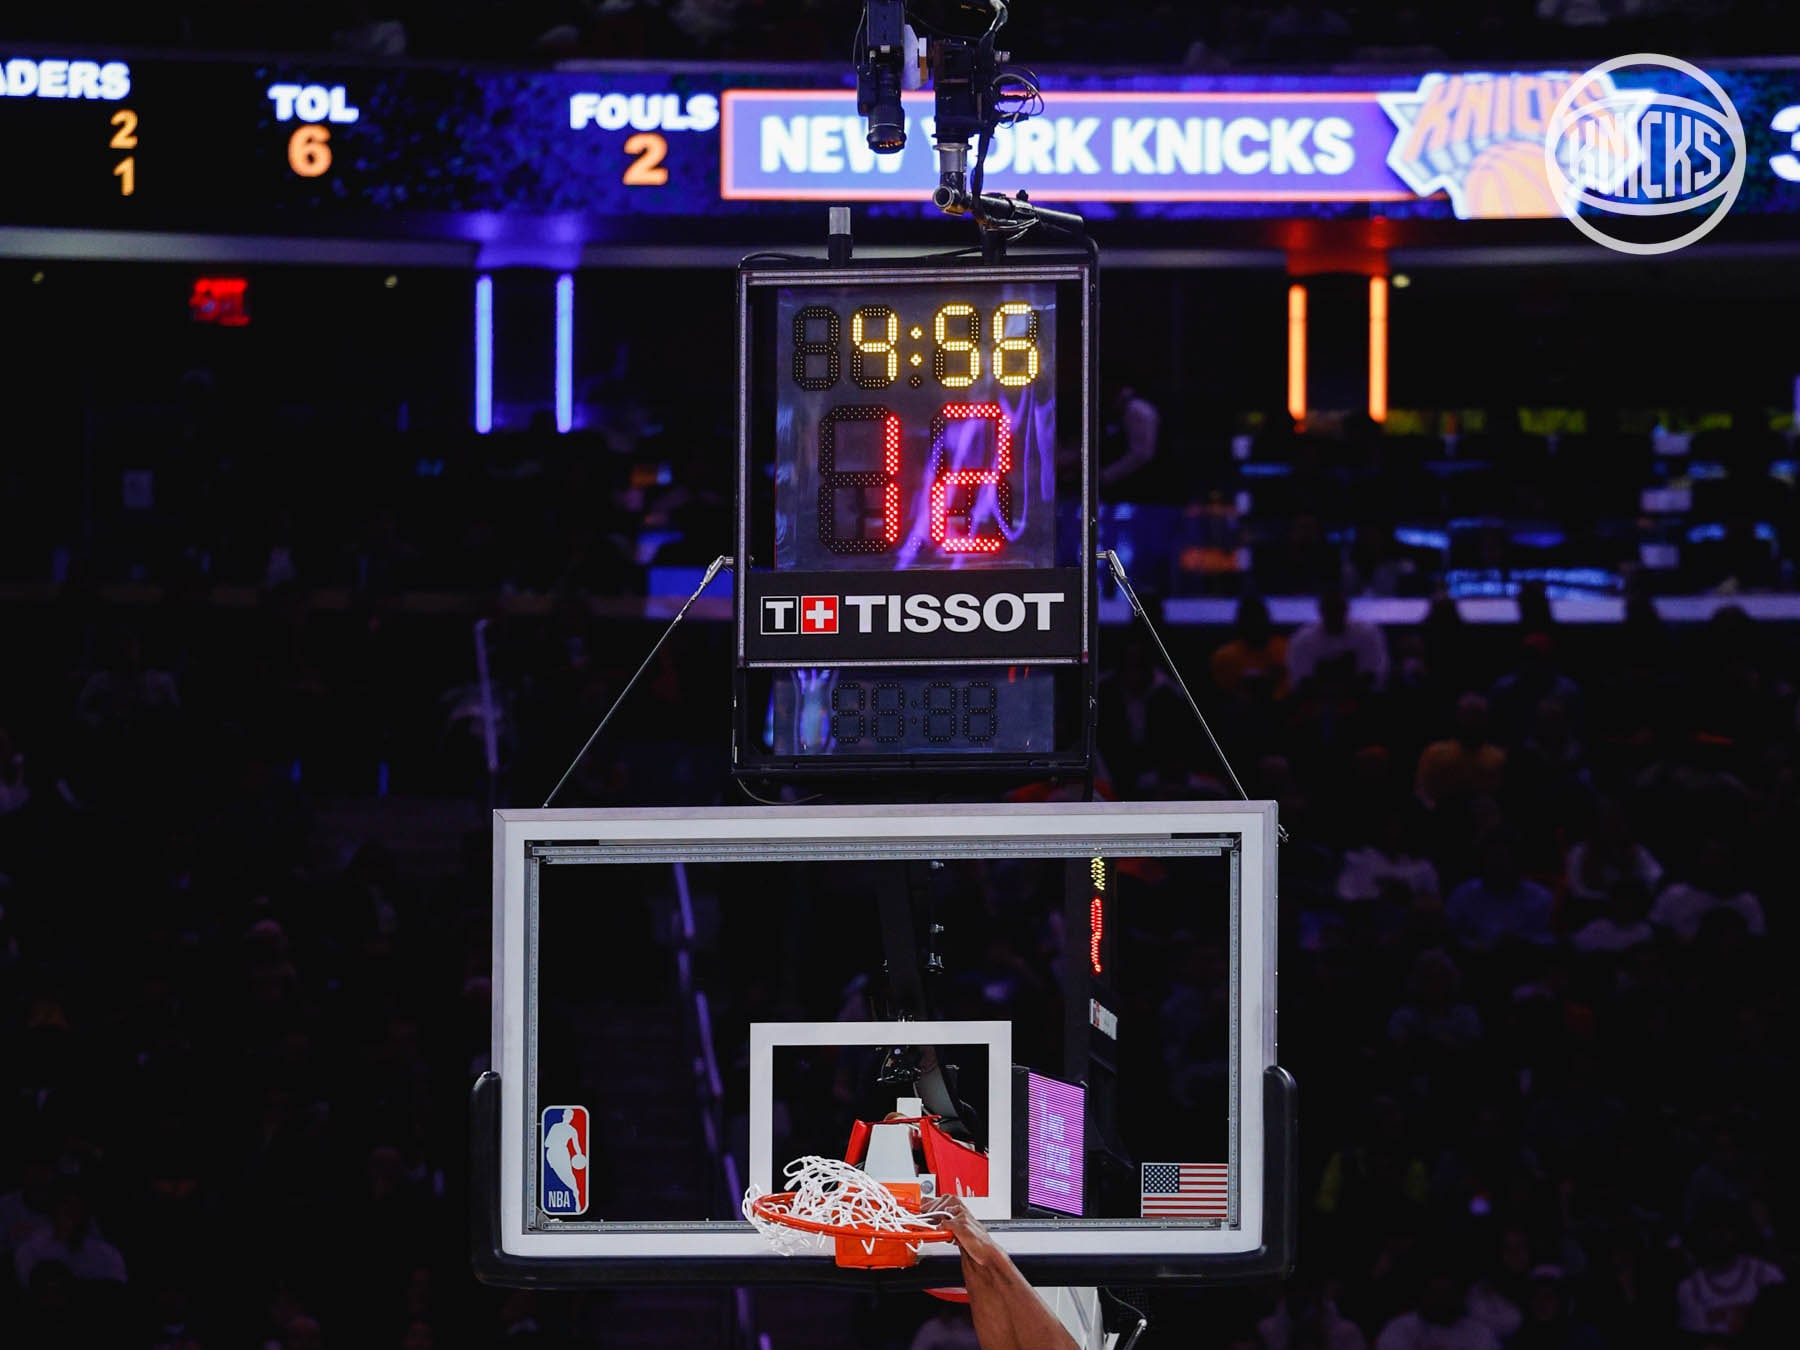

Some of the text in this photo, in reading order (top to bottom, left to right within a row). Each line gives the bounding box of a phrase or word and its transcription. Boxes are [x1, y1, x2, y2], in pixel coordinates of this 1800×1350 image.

[0, 59, 131, 100] DERS
[267, 84, 360, 123] TOL
[569, 93, 720, 131] FOULS
[110, 109, 138, 149] 2
[921, 115, 1101, 175] ORK
[1112, 116, 1356, 176] KNICKS
[288, 124, 333, 177] 6
[622, 133, 669, 185] 2
[113, 157, 135, 196] 1
[851, 302, 1039, 387] 4:56
[884, 403, 1011, 552] 12
[845, 592, 1065, 633] TISSOT
[548, 1190, 571, 1208] NBA
